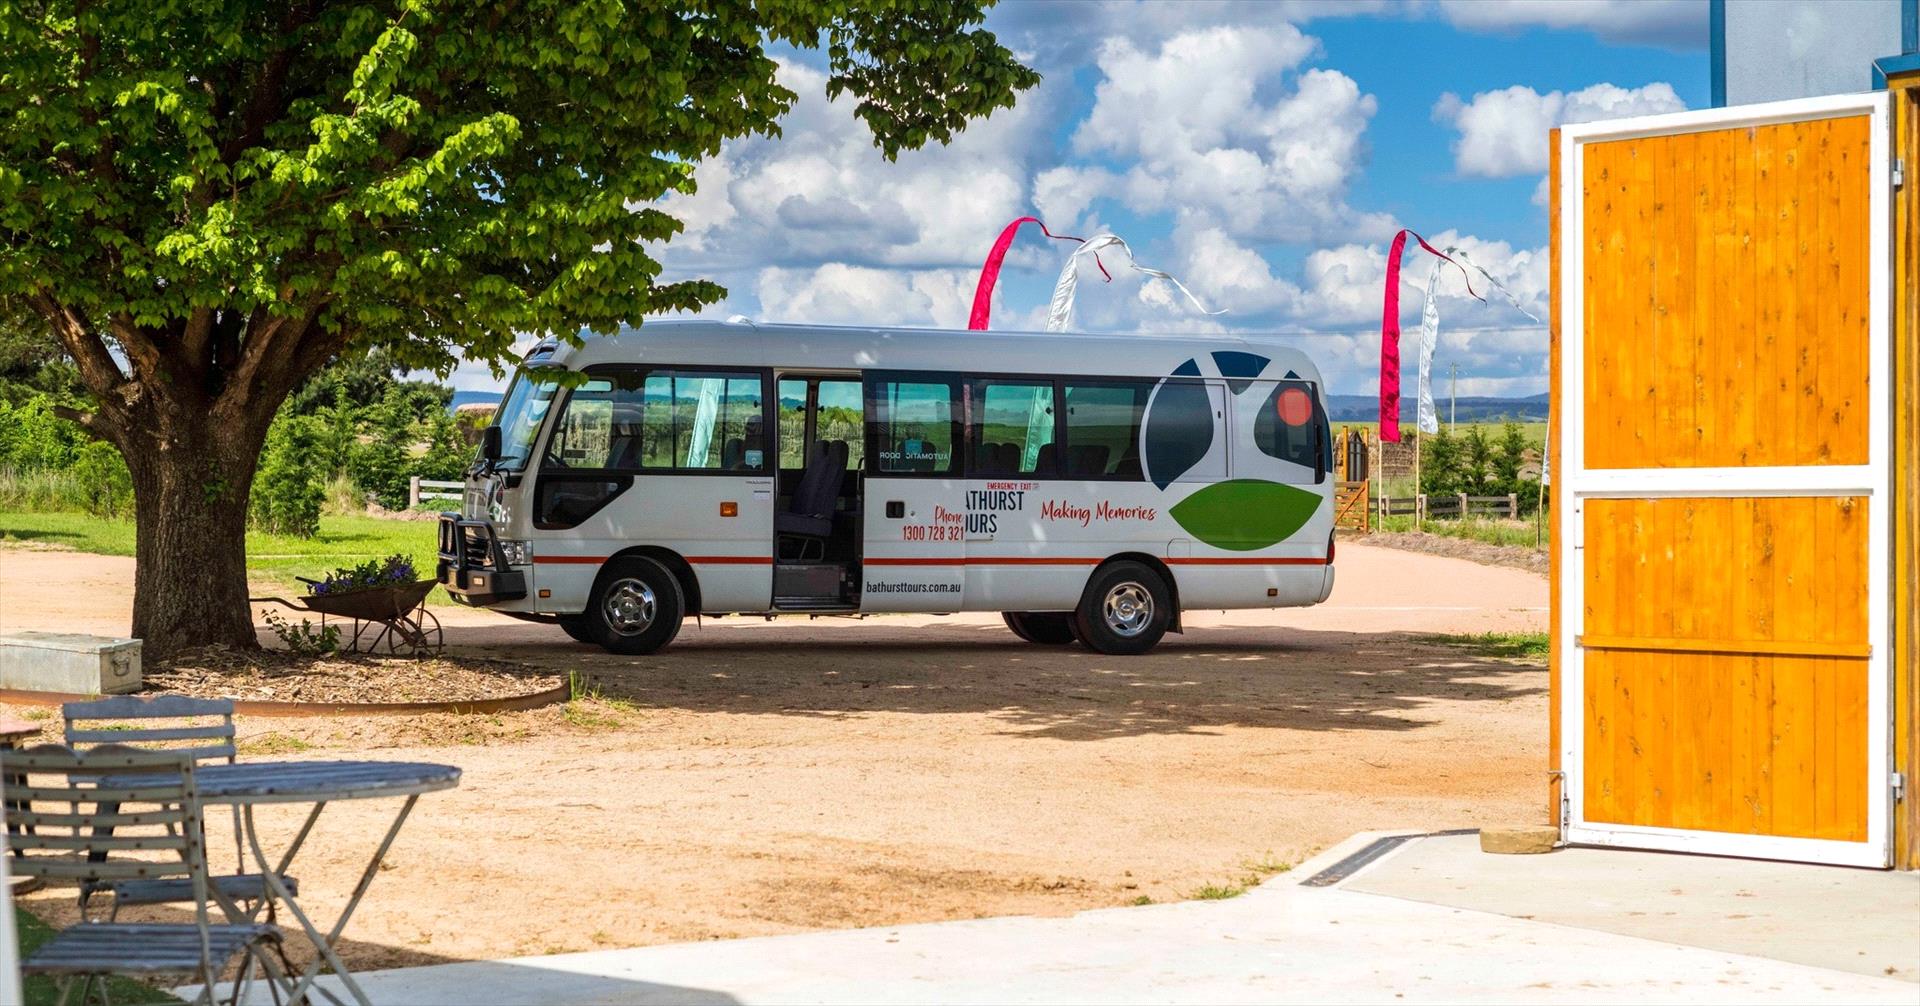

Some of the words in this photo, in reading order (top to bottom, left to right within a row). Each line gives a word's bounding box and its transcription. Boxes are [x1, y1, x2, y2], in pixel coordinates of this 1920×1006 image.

[987, 482, 1018, 490] EMERGENCY
[1020, 482, 1032, 490] EXIT
[934, 505, 963, 526] Phone
[1041, 500, 1091, 528] Making
[1096, 500, 1158, 522] Memories
[903, 525, 925, 541] 1300
[928, 525, 945, 541] 728
[948, 525, 964, 541] 321
[866, 581, 961, 593] bathursttours.com.au
